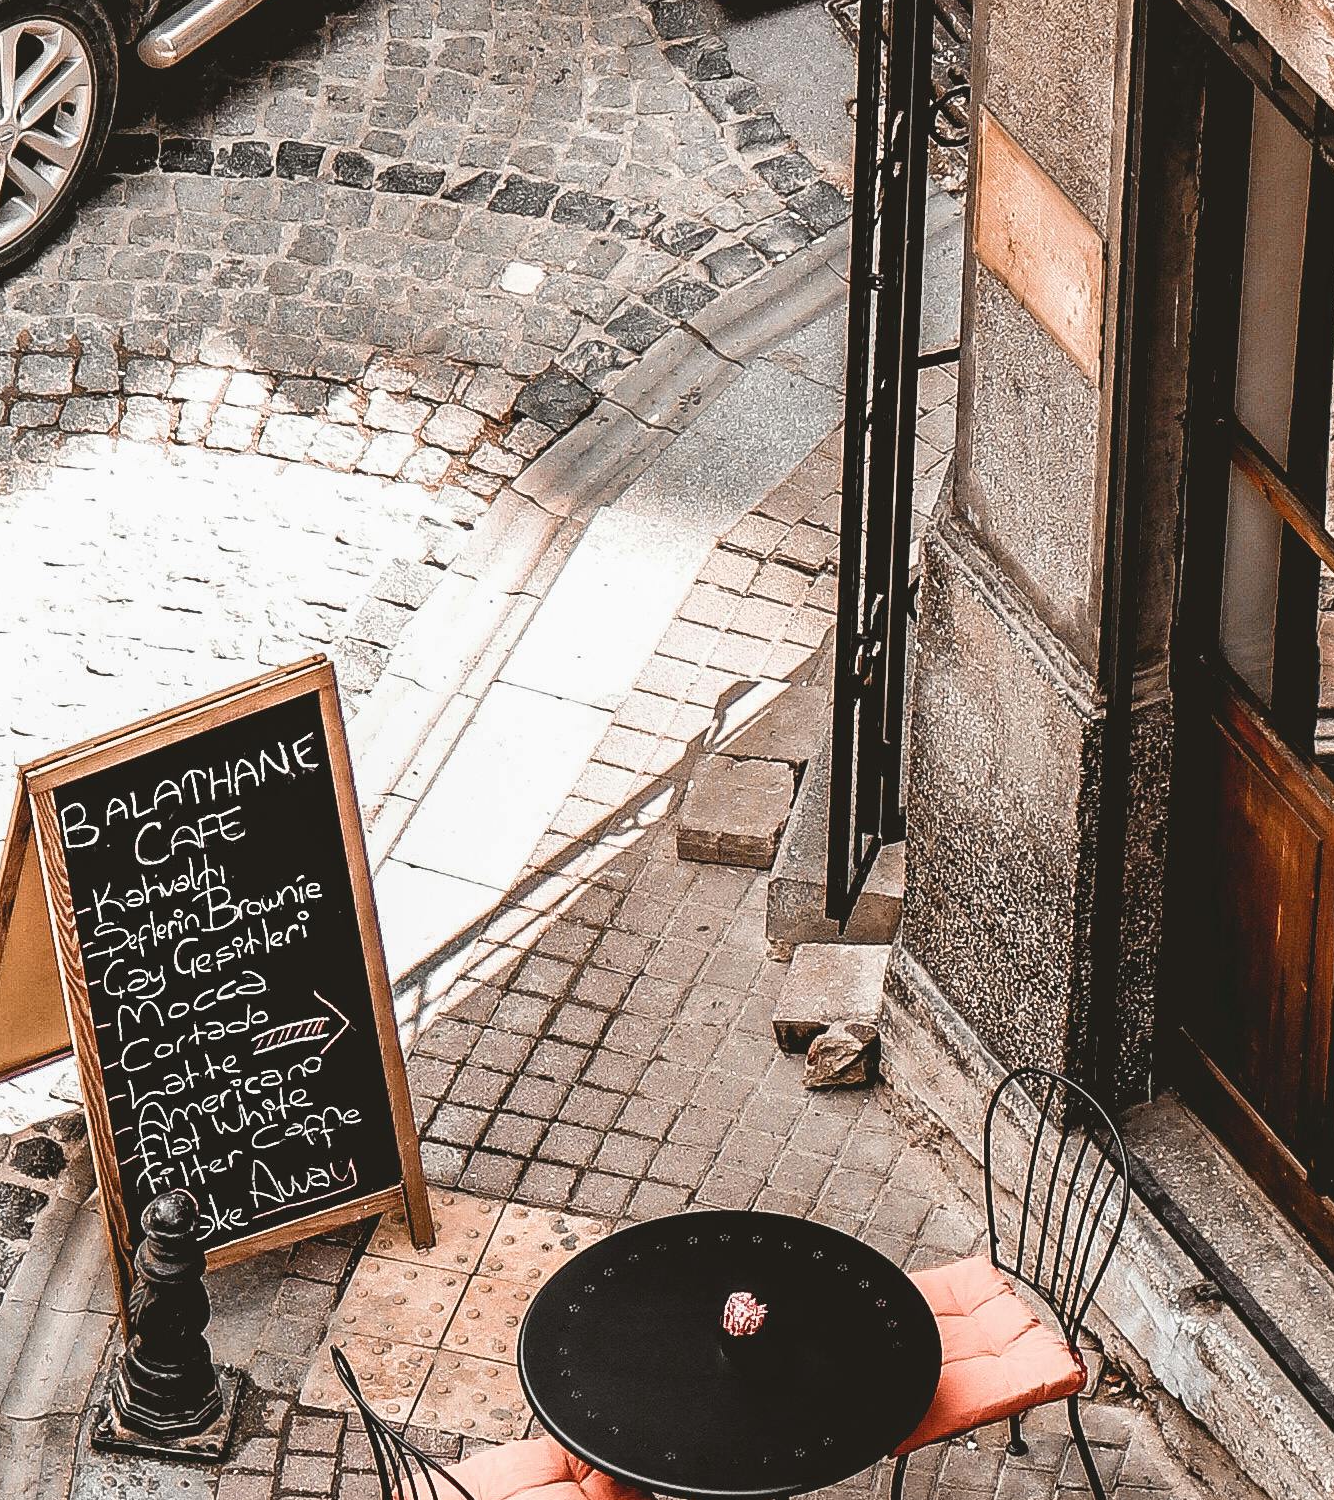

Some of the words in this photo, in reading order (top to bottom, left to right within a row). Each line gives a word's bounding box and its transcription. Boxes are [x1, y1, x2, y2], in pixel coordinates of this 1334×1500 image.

[134, 805, 247, 866] CAFE
[192, 875, 323, 932] Brownie
[118, 970, 267, 1042] Mocca
[120, 1003, 269, 1072] Cortado
[128, 1050, 243, 1110] Latte
[138, 1056, 323, 1133] Americano
[134, 1121, 201, 1168] Flat
[196, 1194, 249, 1242] ake
[249, 1158, 359, 1210] Away
